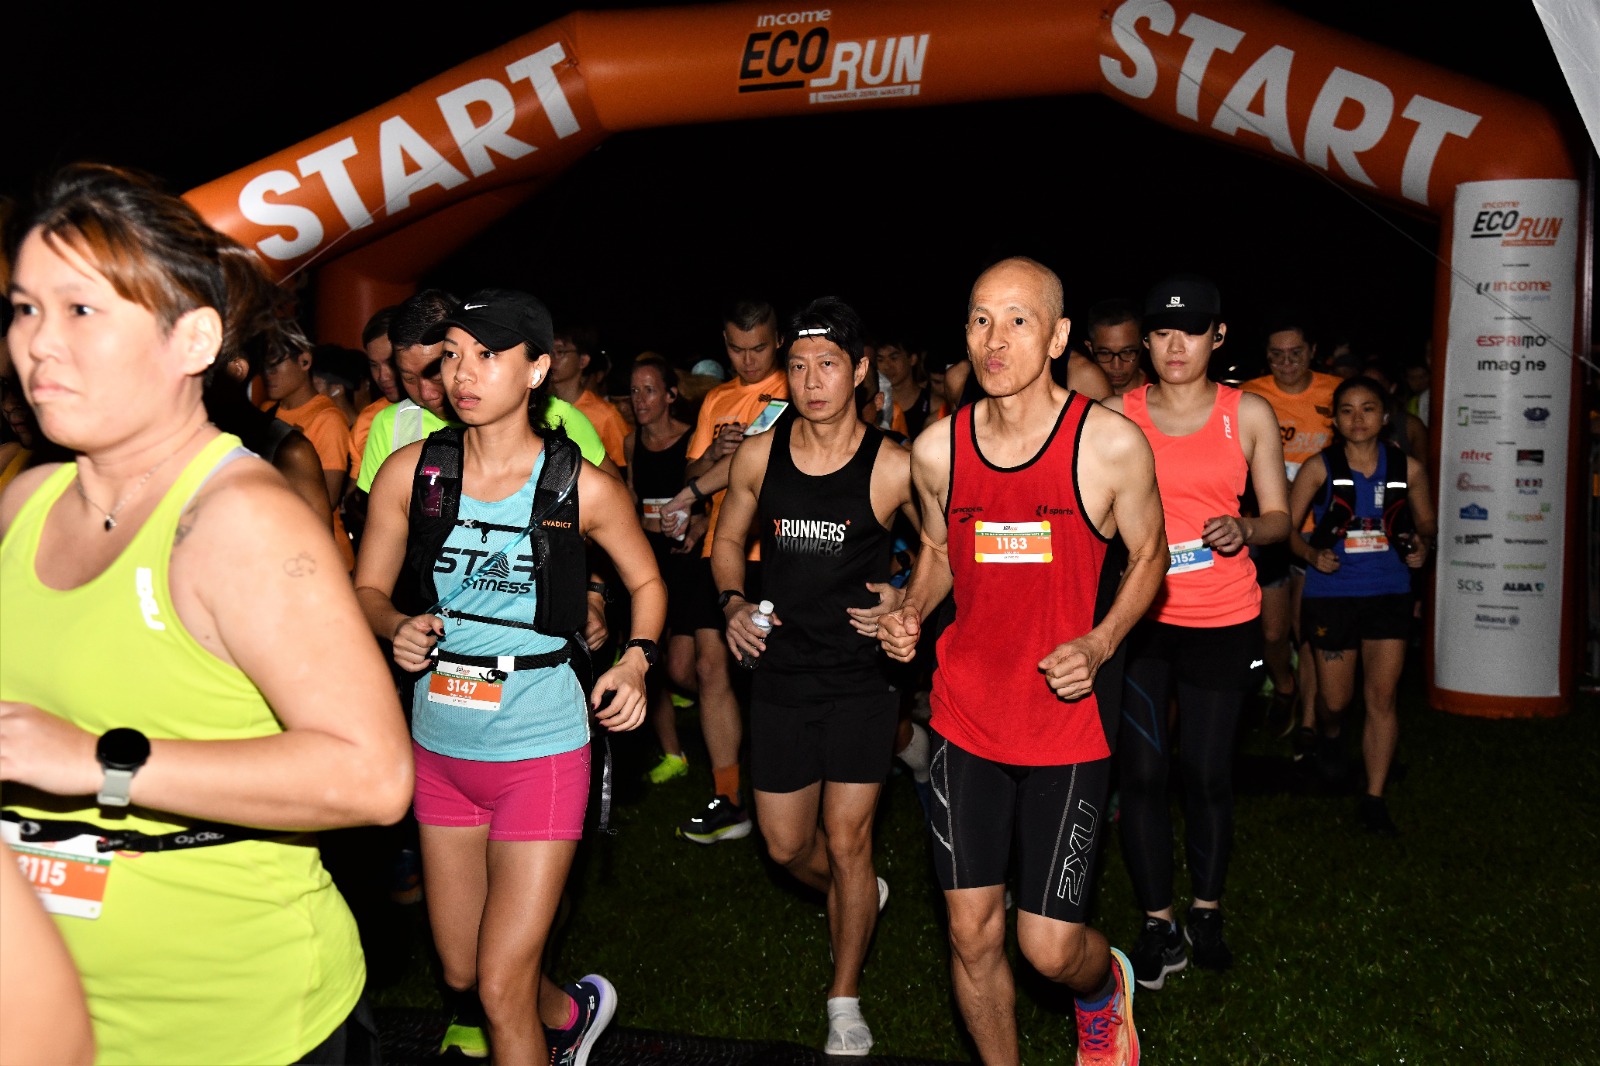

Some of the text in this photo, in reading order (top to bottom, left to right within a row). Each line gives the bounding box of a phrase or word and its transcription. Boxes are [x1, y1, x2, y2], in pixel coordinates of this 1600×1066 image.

[757, 8, 832, 28] income
[740, 26, 930, 90] ECO RUN
[1099, 0, 1482, 207] START
[238, 41, 581, 261] START
[1482, 200, 1520, 209] income
[1473, 210, 1563, 240] ECO RUN
[1492, 280, 1552, 292] income
[542, 519, 572, 529] EVADICT
[772, 518, 847, 543] XRUNNERS
[996, 537, 1028, 551] 1183
[446, 678, 478, 695] 3147
[1057, 798, 1099, 907] 2XU
